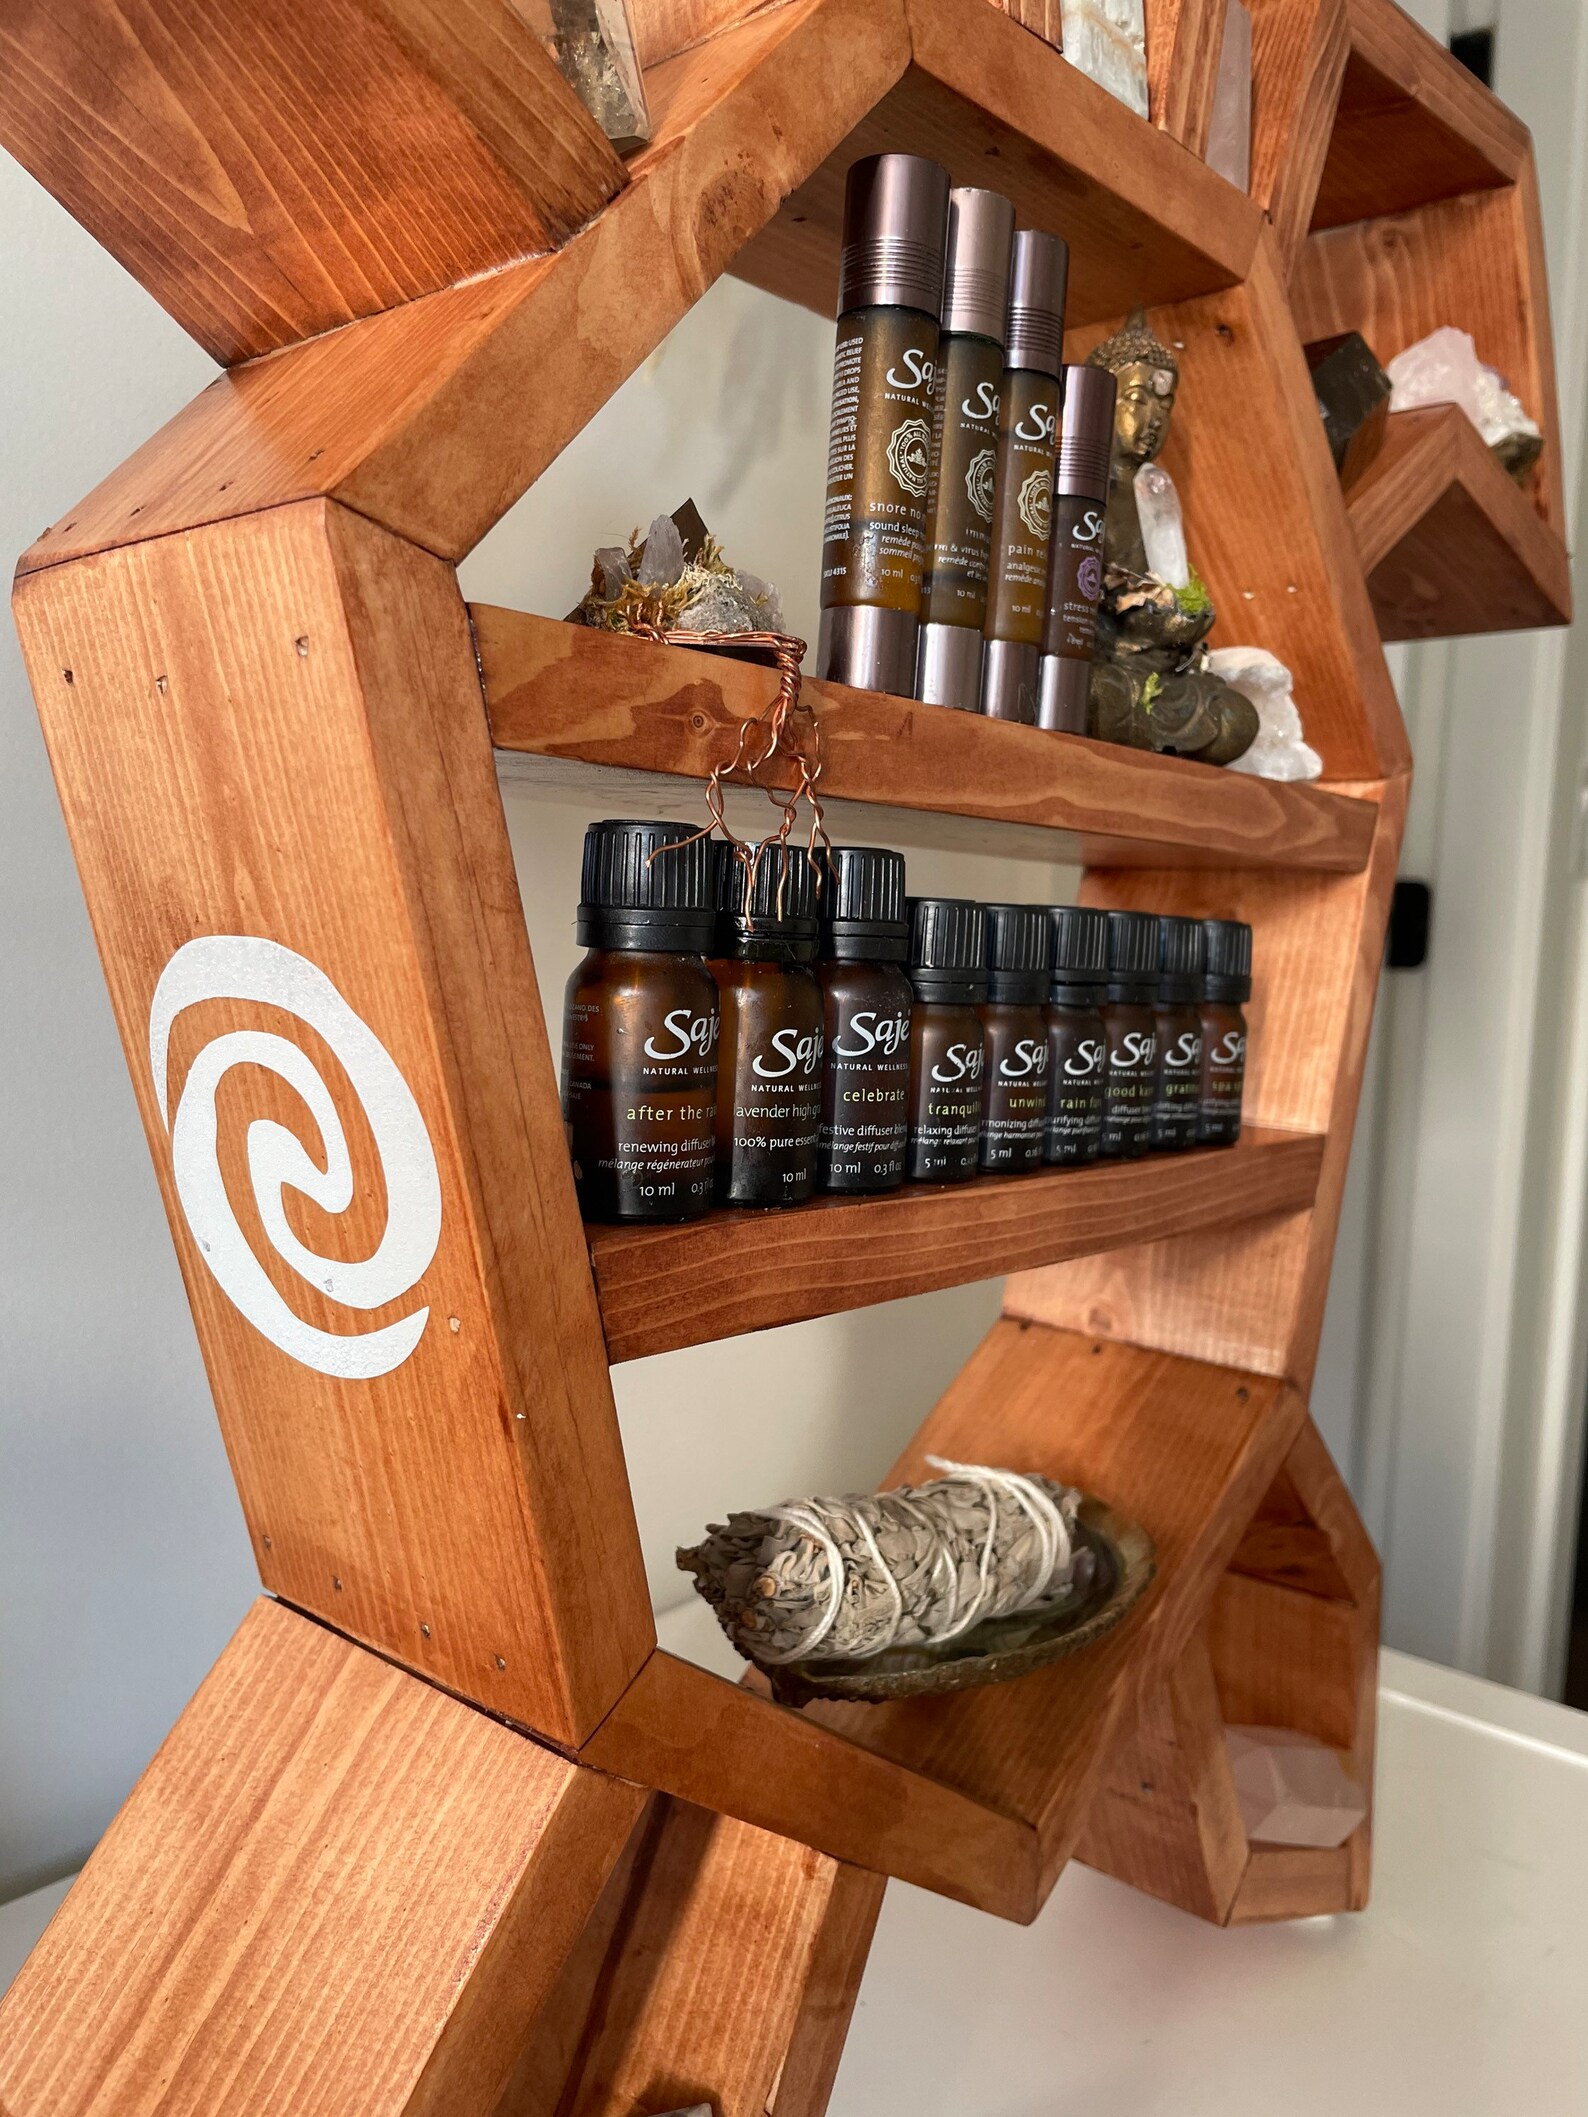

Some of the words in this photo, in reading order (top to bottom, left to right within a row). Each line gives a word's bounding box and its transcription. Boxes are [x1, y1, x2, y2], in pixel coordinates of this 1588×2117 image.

[886, 348, 937, 396] Saj
[884, 392, 920, 406] NATURAL
[960, 422, 990, 435] NATURAL
[1015, 404, 1056, 445] Sa
[1013, 444, 1045, 456] NATURAL
[870, 502, 907, 515] snore
[869, 521, 900, 532] sound
[901, 524, 920, 538] sleep
[1072, 511, 1105, 544] Sa
[881, 535, 911, 548] remède
[879, 547, 913, 560] sommeil
[950, 543, 958, 553] &
[960, 545, 980, 557] virus
[1007, 543, 1034, 556] pain
[938, 555, 969, 567] remède
[833, 566, 847, 576] 4315
[881, 568, 892, 577] 10
[892, 568, 904, 579] ml
[956, 589, 966, 598] 10
[966, 590, 976, 600] ml
[644, 1008, 720, 1060] Saje
[831, 1011, 910, 1057] Saje
[1110, 1031, 1156, 1068] Saj
[1165, 1032, 1201, 1067] Sa
[1210, 1031, 1245, 1065] Sa
[1000, 1038, 1049, 1077] Saj
[642, 1067, 689, 1076] NATURAL
[830, 1062, 873, 1071] NATURAL
[751, 1084, 795, 1093] NATURAL
[997, 1080, 1030, 1088] NATURAL
[1062, 1079, 1092, 1087] NATURAL
[843, 1088, 905, 1102] celebrate
[1104, 1084, 1136, 1099] good
[1060, 1098, 1086, 1110] rain
[626, 1105, 674, 1121] after
[680, 1104, 703, 1120] the
[819, 1123, 855, 1136] festive
[857, 1124, 893, 1137] diffuser
[914, 1124, 953, 1138] relaxing
[1109, 1131, 1122, 1141] ml
[618, 1141, 679, 1157] renewing
[733, 1136, 767, 1148] 100%
[769, 1135, 795, 1151] pure
[818, 1141, 855, 1154] mélange
[854, 1141, 875, 1154] festif
[990, 1150, 997, 1161] 5
[998, 1147, 1012, 1159] ml
[598, 1158, 645, 1173] mélange
[829, 1163, 842, 1174] 10
[845, 1161, 861, 1174] ml
[924, 1157, 931, 1168] 5
[782, 1172, 794, 1183] 10
[795, 1167, 807, 1182] ml
[639, 1186, 655, 1197] 10
[658, 1182, 675, 1196] ml
